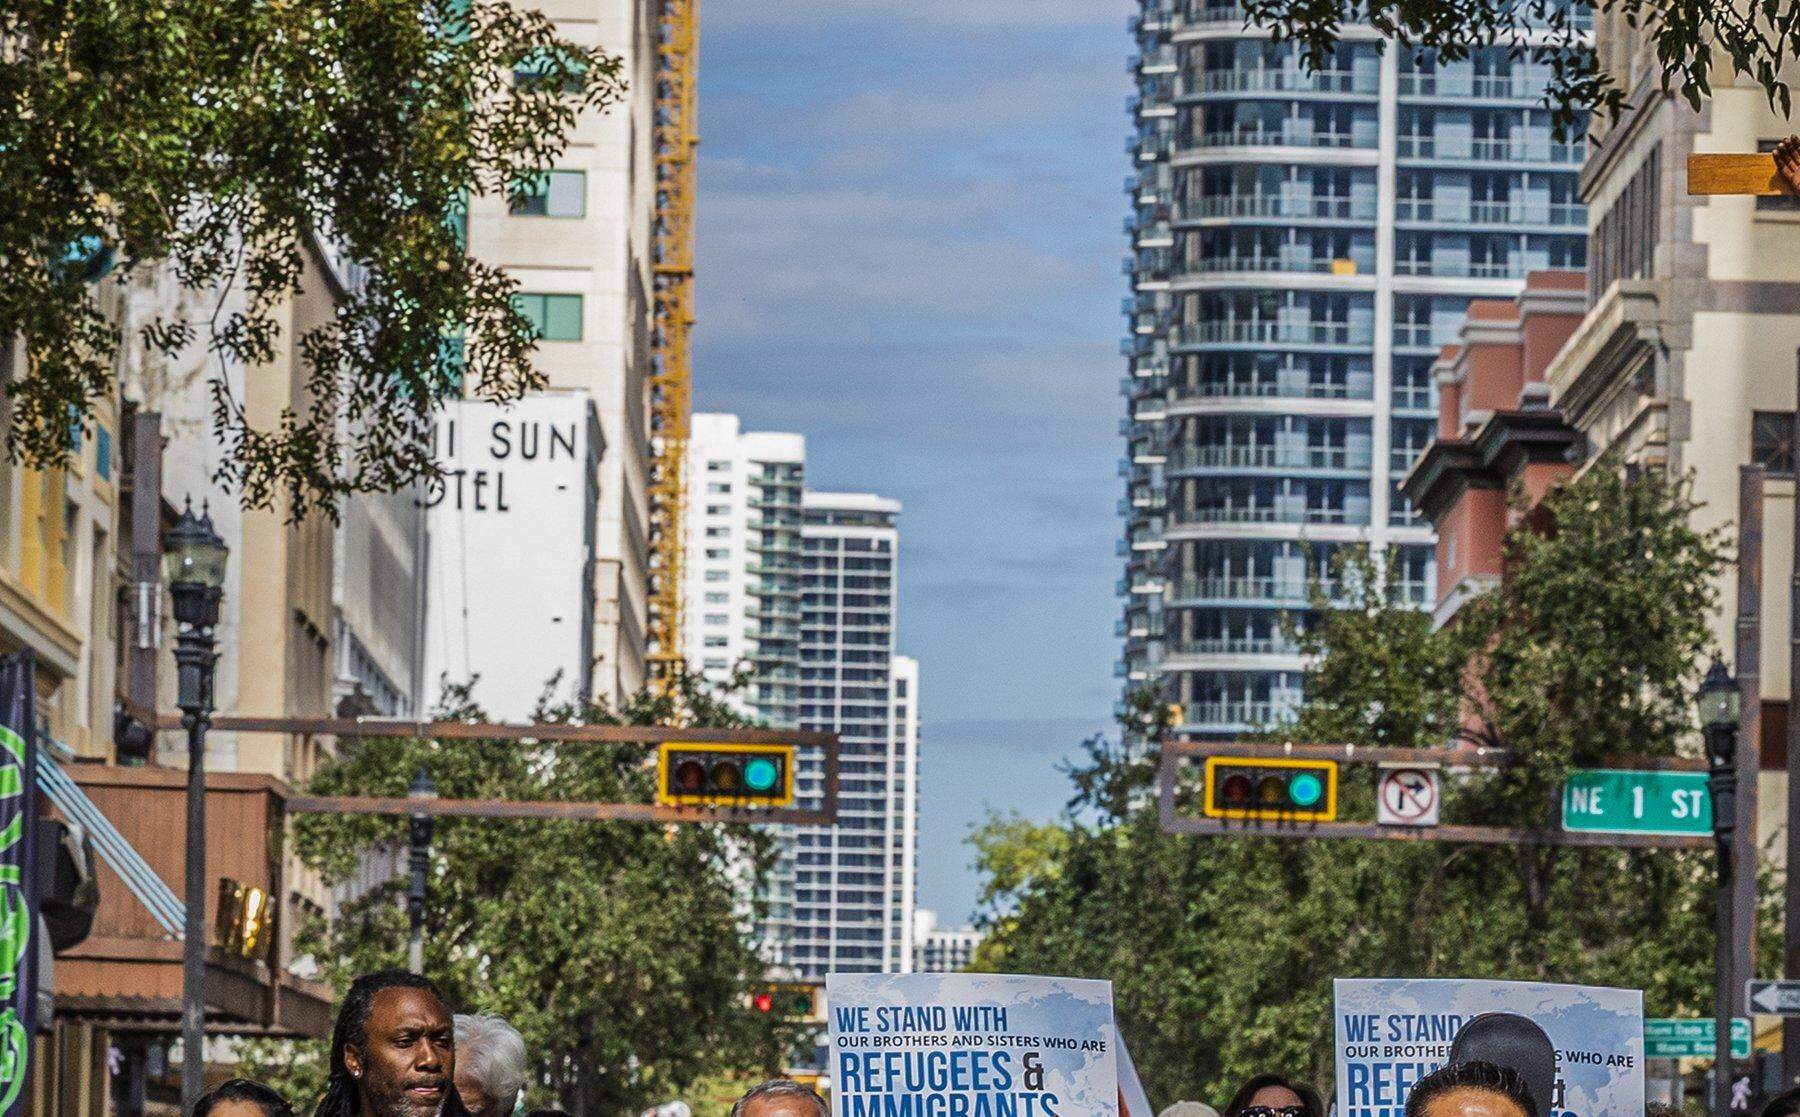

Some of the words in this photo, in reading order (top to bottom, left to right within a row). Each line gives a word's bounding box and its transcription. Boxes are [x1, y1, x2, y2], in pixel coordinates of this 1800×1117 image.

[490, 421, 576, 460] SUN
[414, 469, 509, 511] OTEL
[1571, 785, 1604, 815] NE
[1632, 785, 1644, 819] 1
[1671, 788, 1703, 819] ST
[836, 1006, 870, 1033] WE
[877, 1006, 946, 1033] STAND
[953, 1006, 1007, 1032] WITH
[1344, 1014, 1379, 1042] WE
[1388, 1014, 1463, 1042] STAND
[837, 1035, 869, 1048] OUR
[873, 1034, 948, 1048] BROTHERS
[952, 1034, 983, 1046] AND
[987, 1035, 1040, 1047] SISTERS
[1043, 1037, 1077, 1051] WHO
[1081, 1040, 1106, 1053] ARE
[1345, 1045, 1378, 1059] OUR
[1384, 1045, 1452, 1058] BROTHE
[1566, 1050, 1603, 1065] WHO
[1606, 1053, 1634, 1069] ARE
[840, 1051, 1012, 1093] REFUGEES
[1022, 1051, 1044, 1091] &
